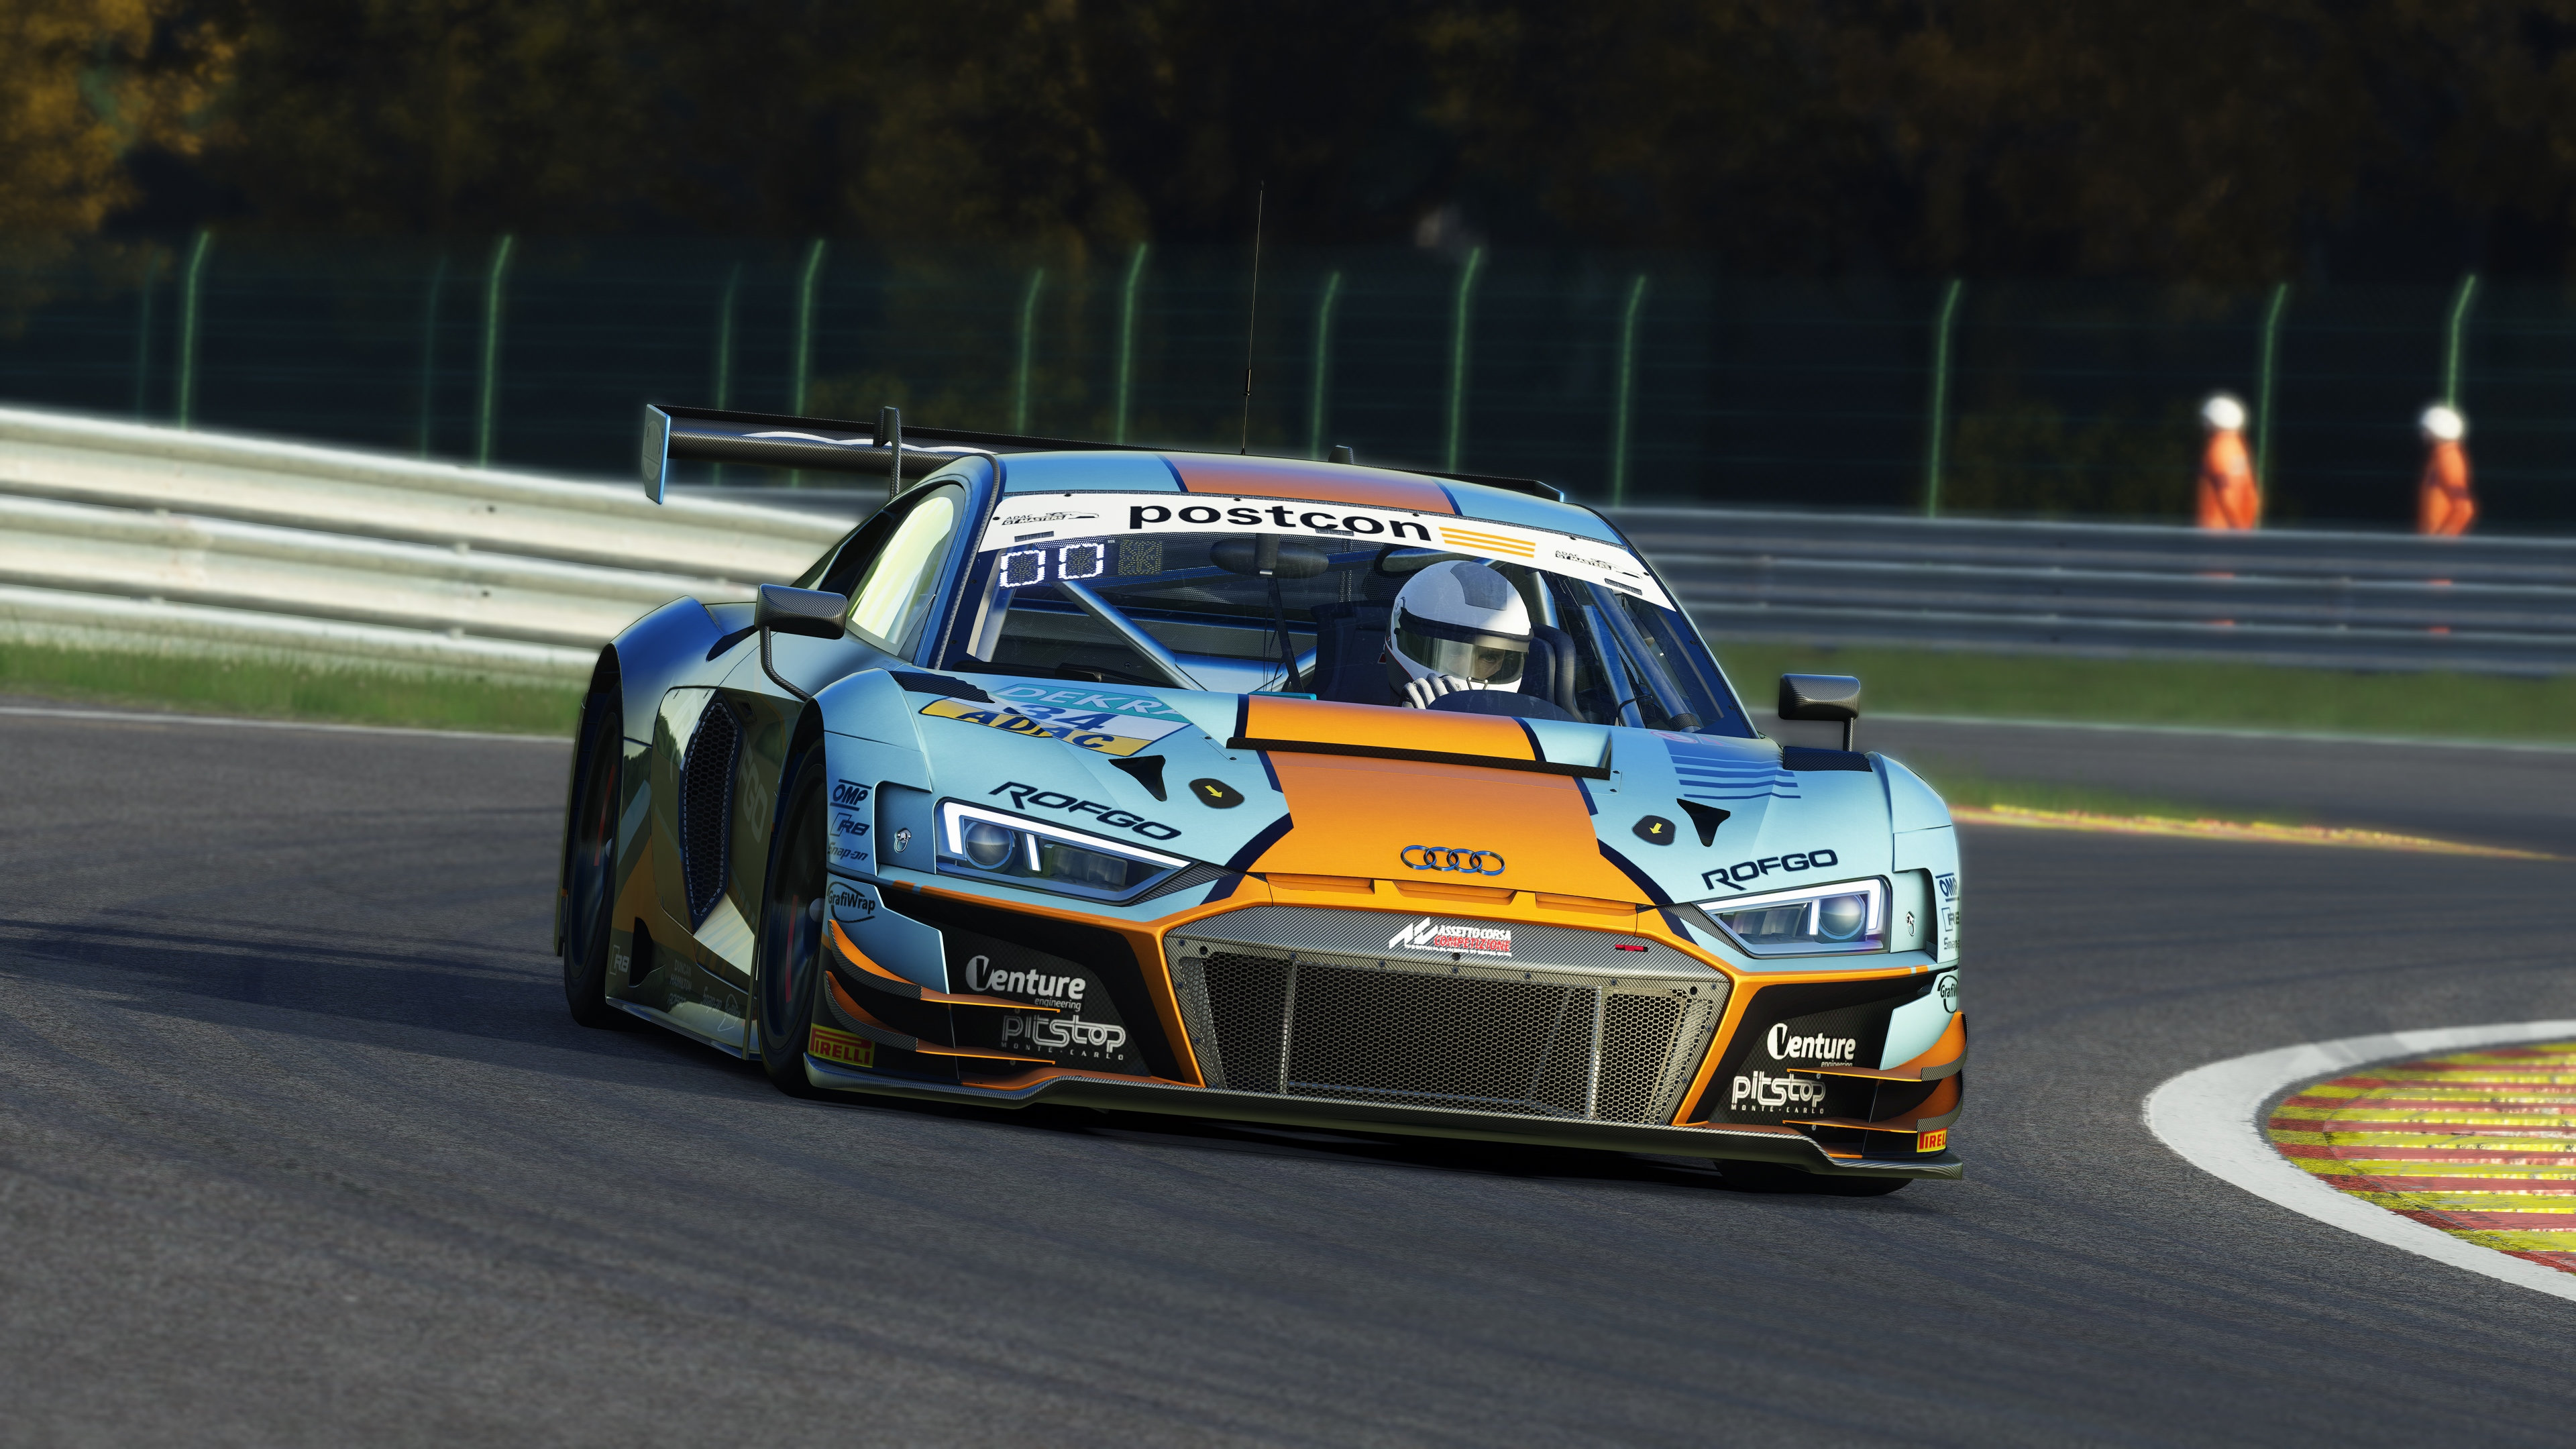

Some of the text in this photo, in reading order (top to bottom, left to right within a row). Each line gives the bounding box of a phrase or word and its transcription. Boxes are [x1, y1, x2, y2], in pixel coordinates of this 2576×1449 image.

[1019, 515, 1064, 524] MASTERS
[1130, 505, 1432, 541] postcon
[955, 711, 1115, 748] ADAC
[833, 784, 869, 806] OMP
[988, 782, 1181, 840] ROFGO
[835, 817, 870, 837] R8
[827, 842, 869, 861] Snap-on
[1701, 849, 1838, 891] ROFGO
[828, 890, 875, 914] GrafiWrap
[1434, 934, 1511, 952] COMPETIZIONE
[1438, 924, 1511, 941] ASSETTO CORSA
[966, 955, 1086, 1000] Venture
[1034, 997, 1081, 1012] engineering
[810, 1027, 873, 1065] PIRELLI
[1002, 1014, 1126, 1053] pitstop
[1767, 1023, 1856, 1060] Venture
[1731, 1071, 1826, 1108] pitstop
[1919, 1128, 1947, 1150] PIREL
